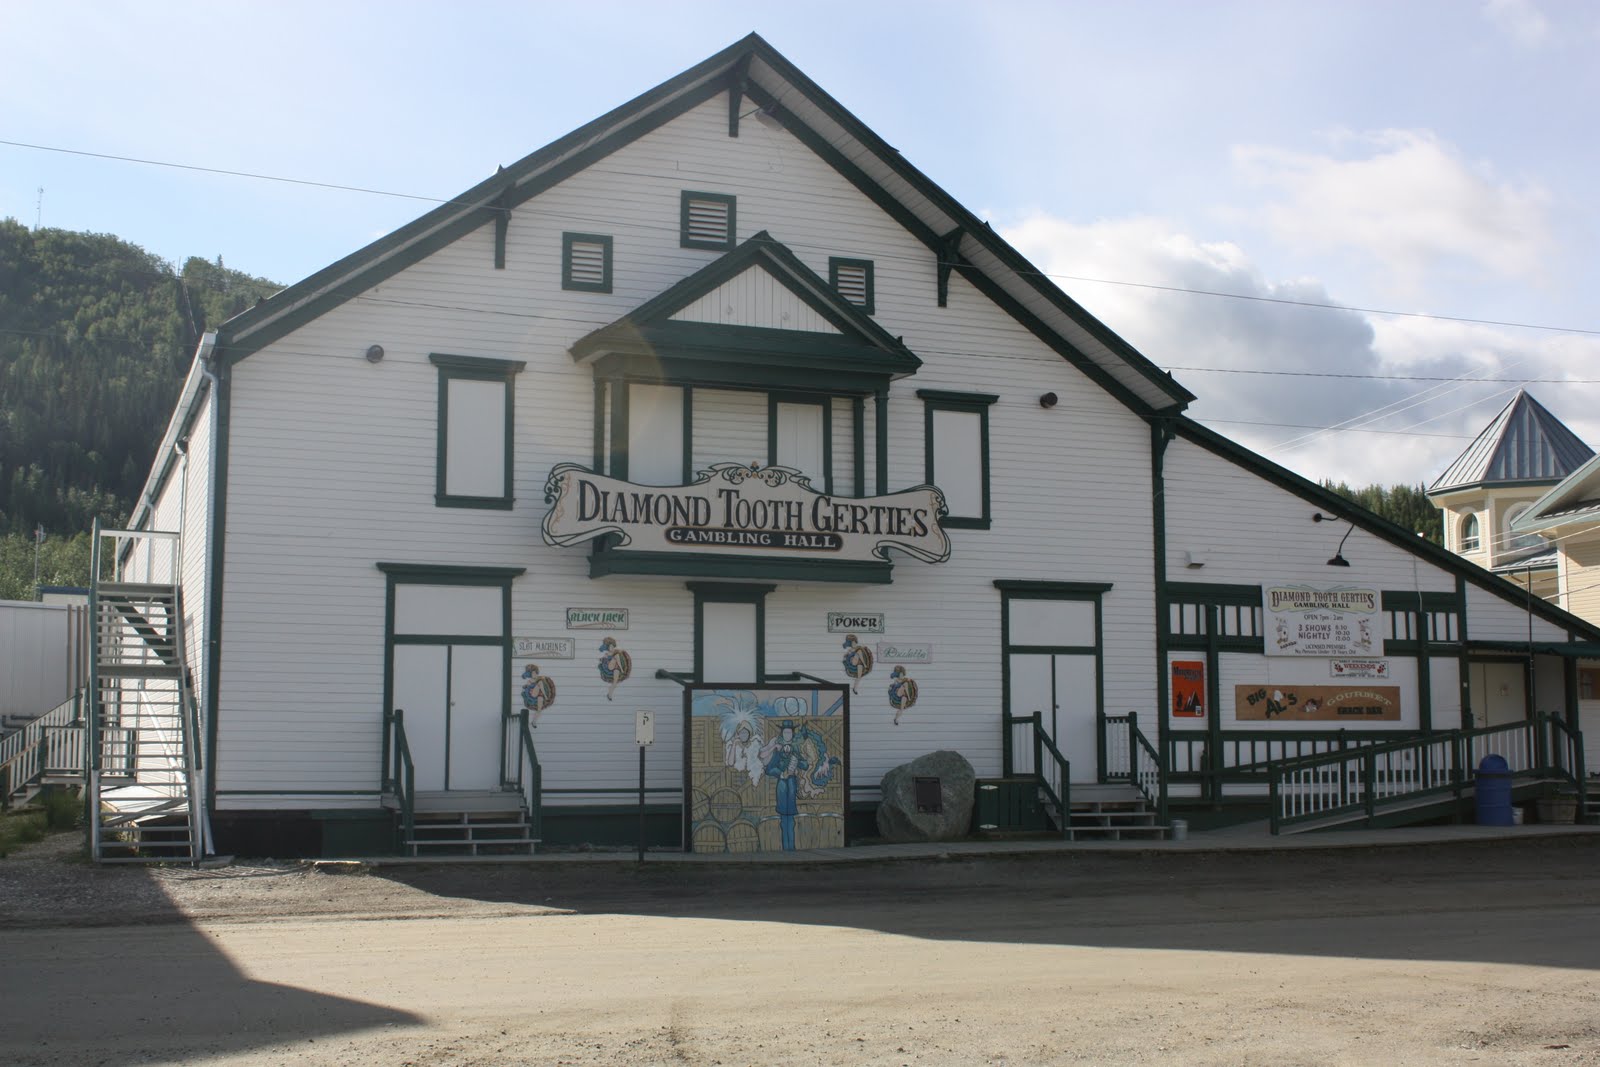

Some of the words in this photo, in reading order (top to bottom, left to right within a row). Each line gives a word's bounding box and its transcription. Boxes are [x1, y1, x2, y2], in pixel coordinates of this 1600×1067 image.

[577, 479, 711, 528] DIAMOND
[718, 488, 803, 532] TOOTH
[811, 496, 929, 538] GERTIES
[670, 529, 772, 546] GAMBLING
[784, 534, 837, 549] HALL
[1271, 590, 1311, 608] DIAMOND
[1313, 592, 1339, 603] TOOTH
[1340, 593, 1375, 609] GERTIES
[570, 612, 600, 623] BLACK
[601, 612, 625, 624] JACK
[834, 617, 878, 628] POKER
[1298, 624, 1303, 632] 3
[1305, 624, 1332, 632] SHOWS
[1298, 632, 1331, 640] NIGHTLY
[519, 641, 533, 651] SLOT
[535, 641, 567, 652] MACHINES
[1246, 687, 1267, 706] BIG
[1327, 691, 1393, 707] GOURMET
